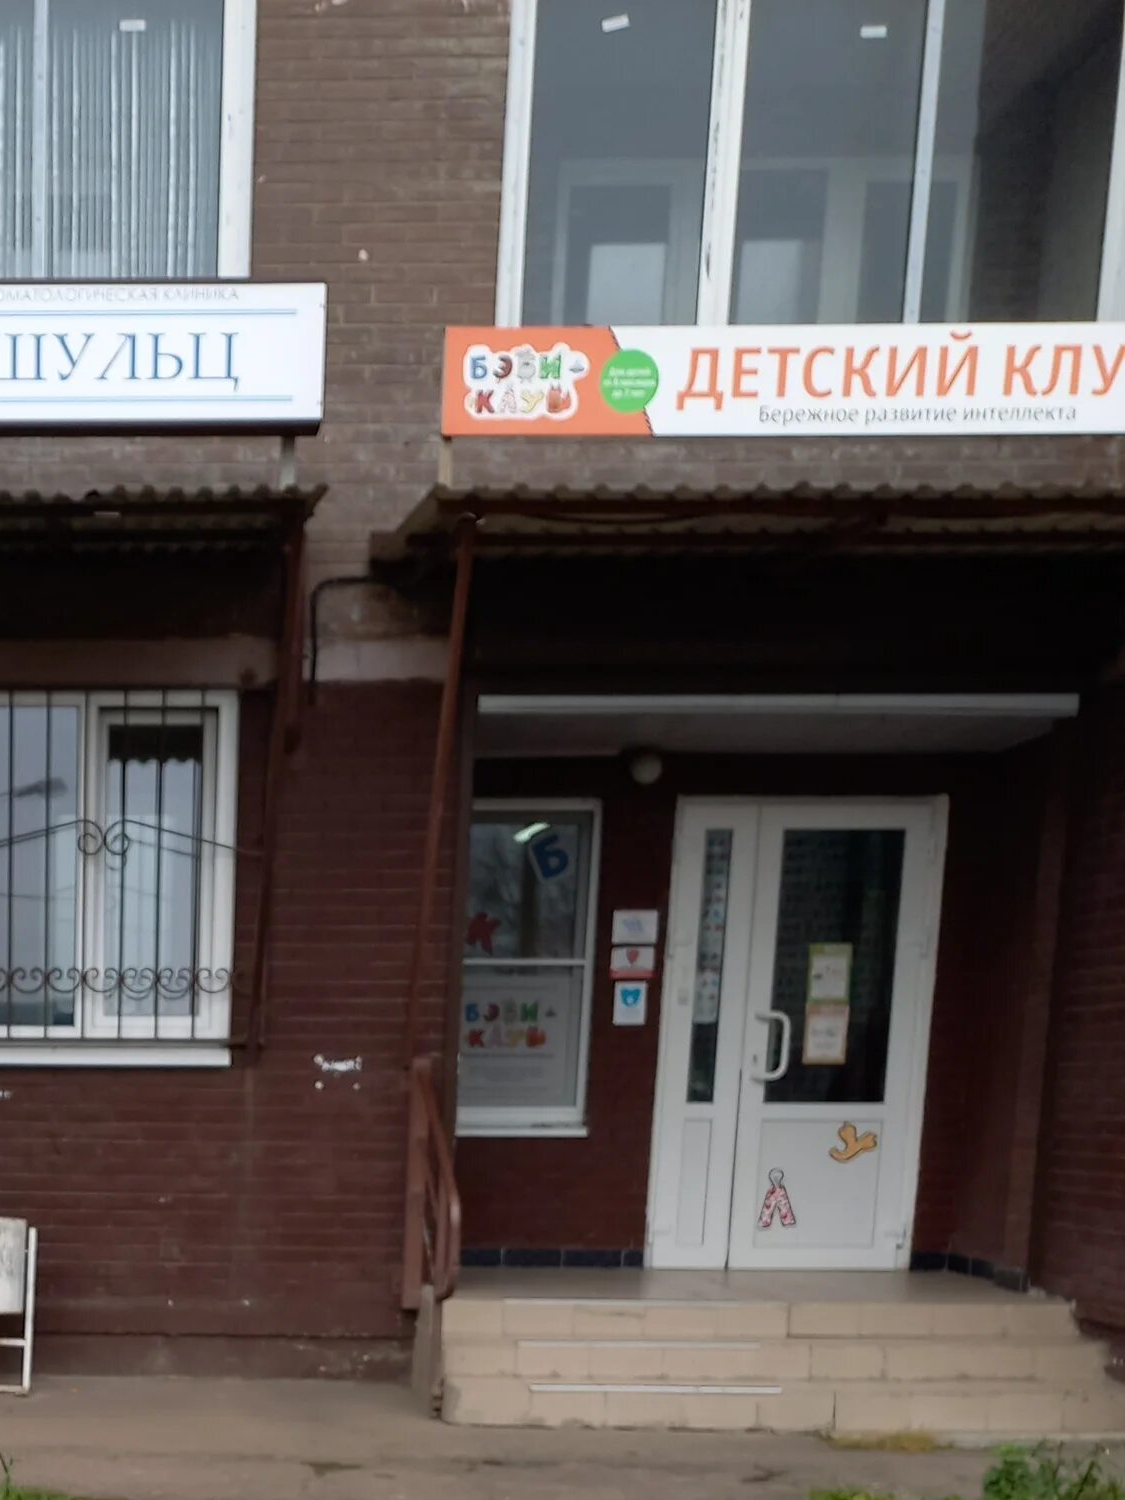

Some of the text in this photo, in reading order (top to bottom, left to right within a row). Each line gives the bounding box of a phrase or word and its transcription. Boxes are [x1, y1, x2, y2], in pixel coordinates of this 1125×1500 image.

[163, 286, 240, 301] КЛИНИКА
[675, 330, 1125, 411] ДЕТСКИЙ КЛУ
[757, 405, 1077, 426] Бережное развитие интеллекта
